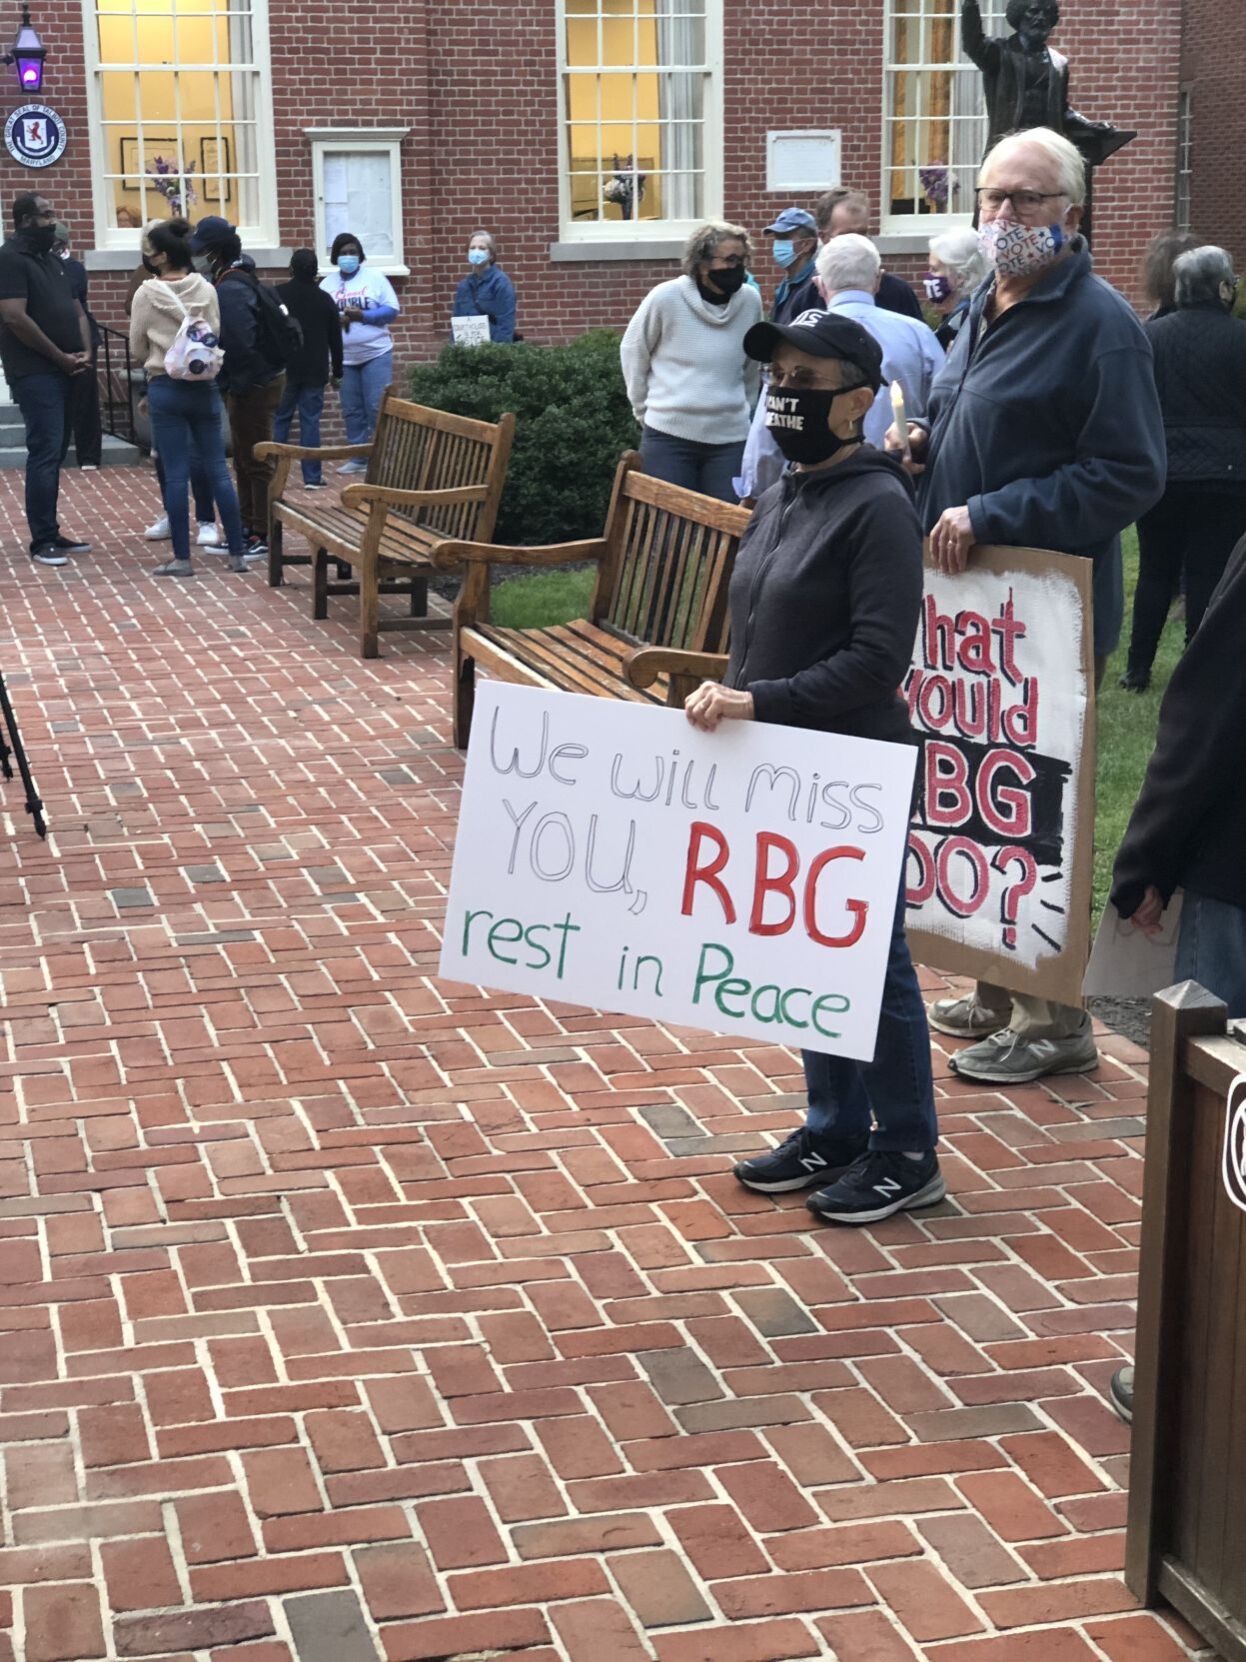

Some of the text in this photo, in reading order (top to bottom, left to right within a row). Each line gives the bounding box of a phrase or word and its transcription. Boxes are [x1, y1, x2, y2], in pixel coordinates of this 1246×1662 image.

[995, 227, 1024, 250] OTE
[1002, 233, 1039, 259] VOTE
[1035, 236, 1055, 253] VO
[997, 255, 1025, 272] OTE
[923, 279, 943, 300] TE
[766, 395, 800, 412] AN'T
[921, 586, 1026, 688] hat
[490, 705, 885, 833] We will miss
[920, 740, 1037, 838] BG
[680, 821, 870, 948] RBG
[462, 909, 851, 1039] rest in Peace
[800, 1152, 828, 1171] N
[873, 1177, 902, 1199] N
